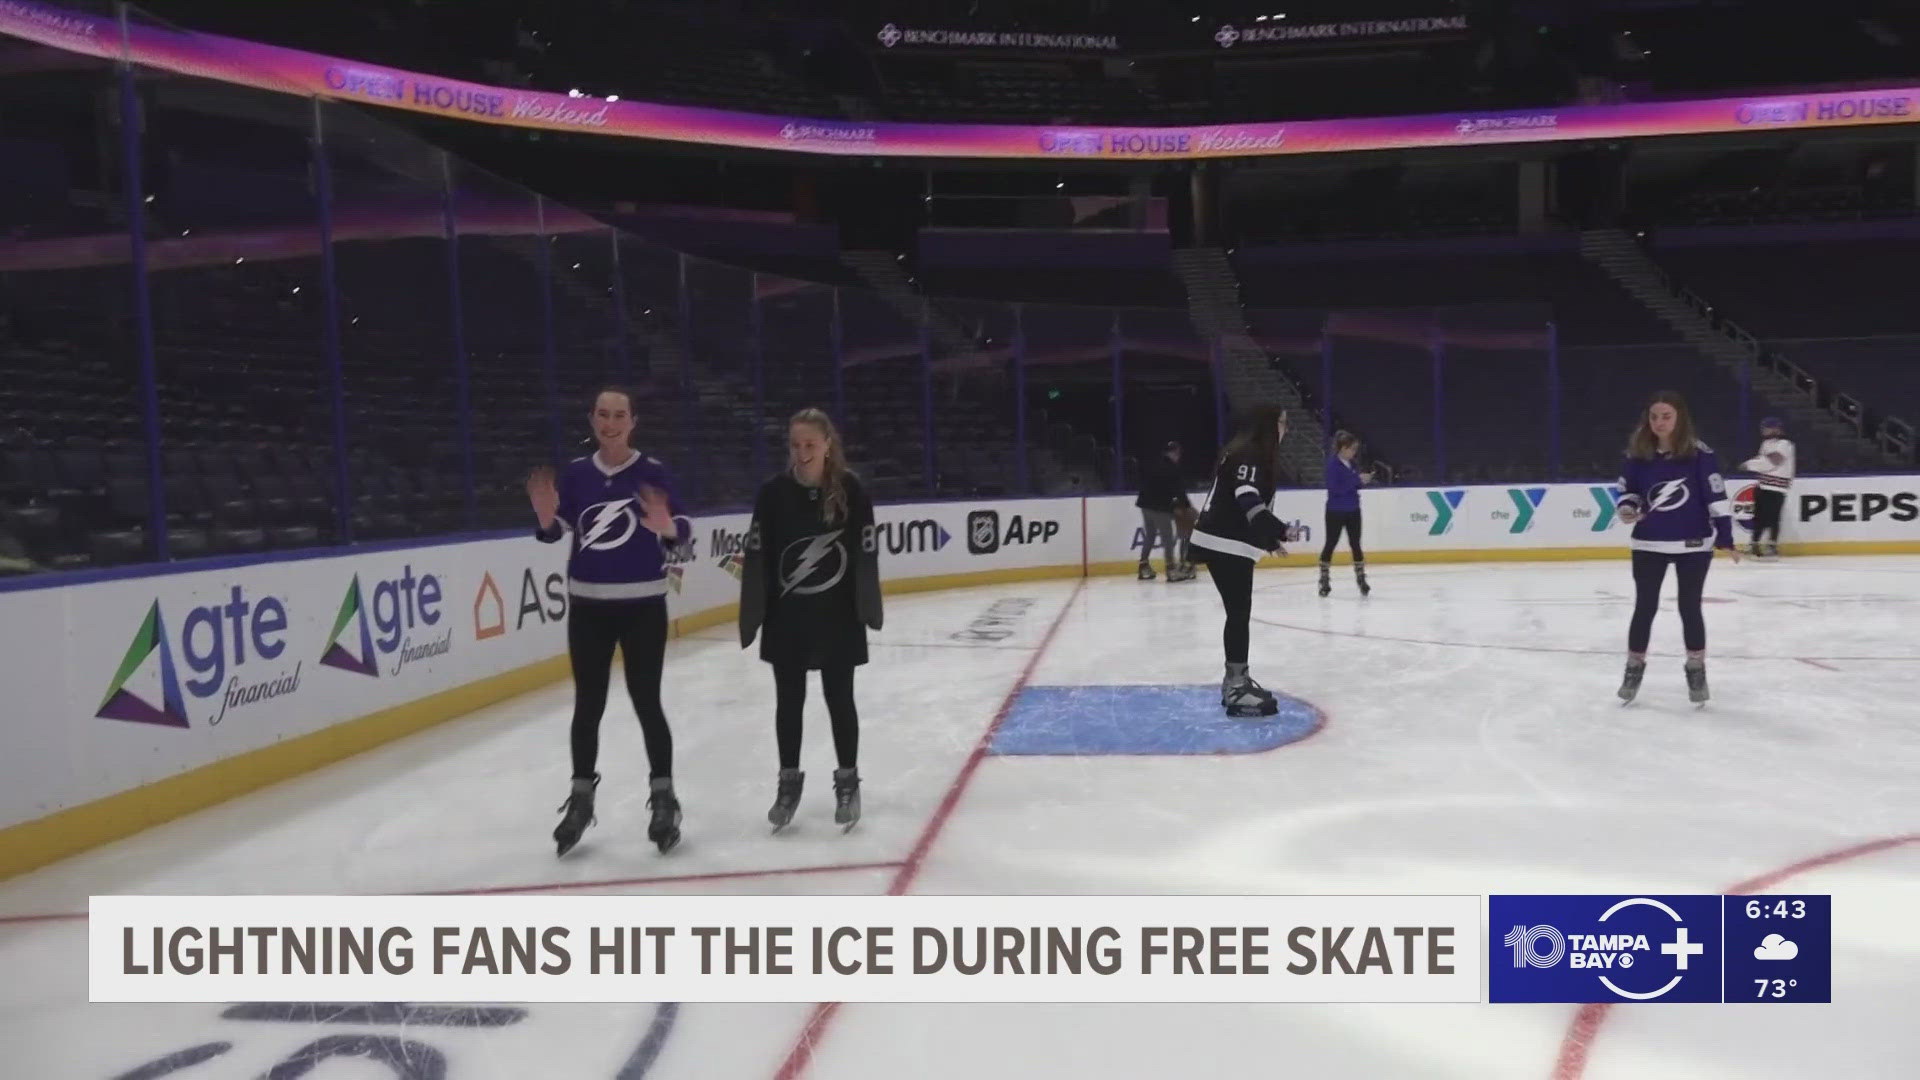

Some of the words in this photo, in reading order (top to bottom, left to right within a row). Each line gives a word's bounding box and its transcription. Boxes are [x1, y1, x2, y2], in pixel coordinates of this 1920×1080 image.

[904, 30, 997, 46] BENCHMARK
[1242, 24, 1338, 42] BENCHMARK
[325, 67, 404, 99] OPEN
[413, 84, 504, 117] HOUSE
[510, 99, 608, 127] Weekend
[1816, 97, 1911, 120] HOUSE
[1111, 133, 1191, 154] HOUSE
[1199, 129, 1285, 153] Weekend
[1237, 465, 1257, 483] 91
[1799, 492, 1920, 522] PEPS
[372, 565, 442, 653] gte
[182, 586, 288, 698] gte
[391, 627, 452, 676] financial
[208, 661, 302, 726] financial
